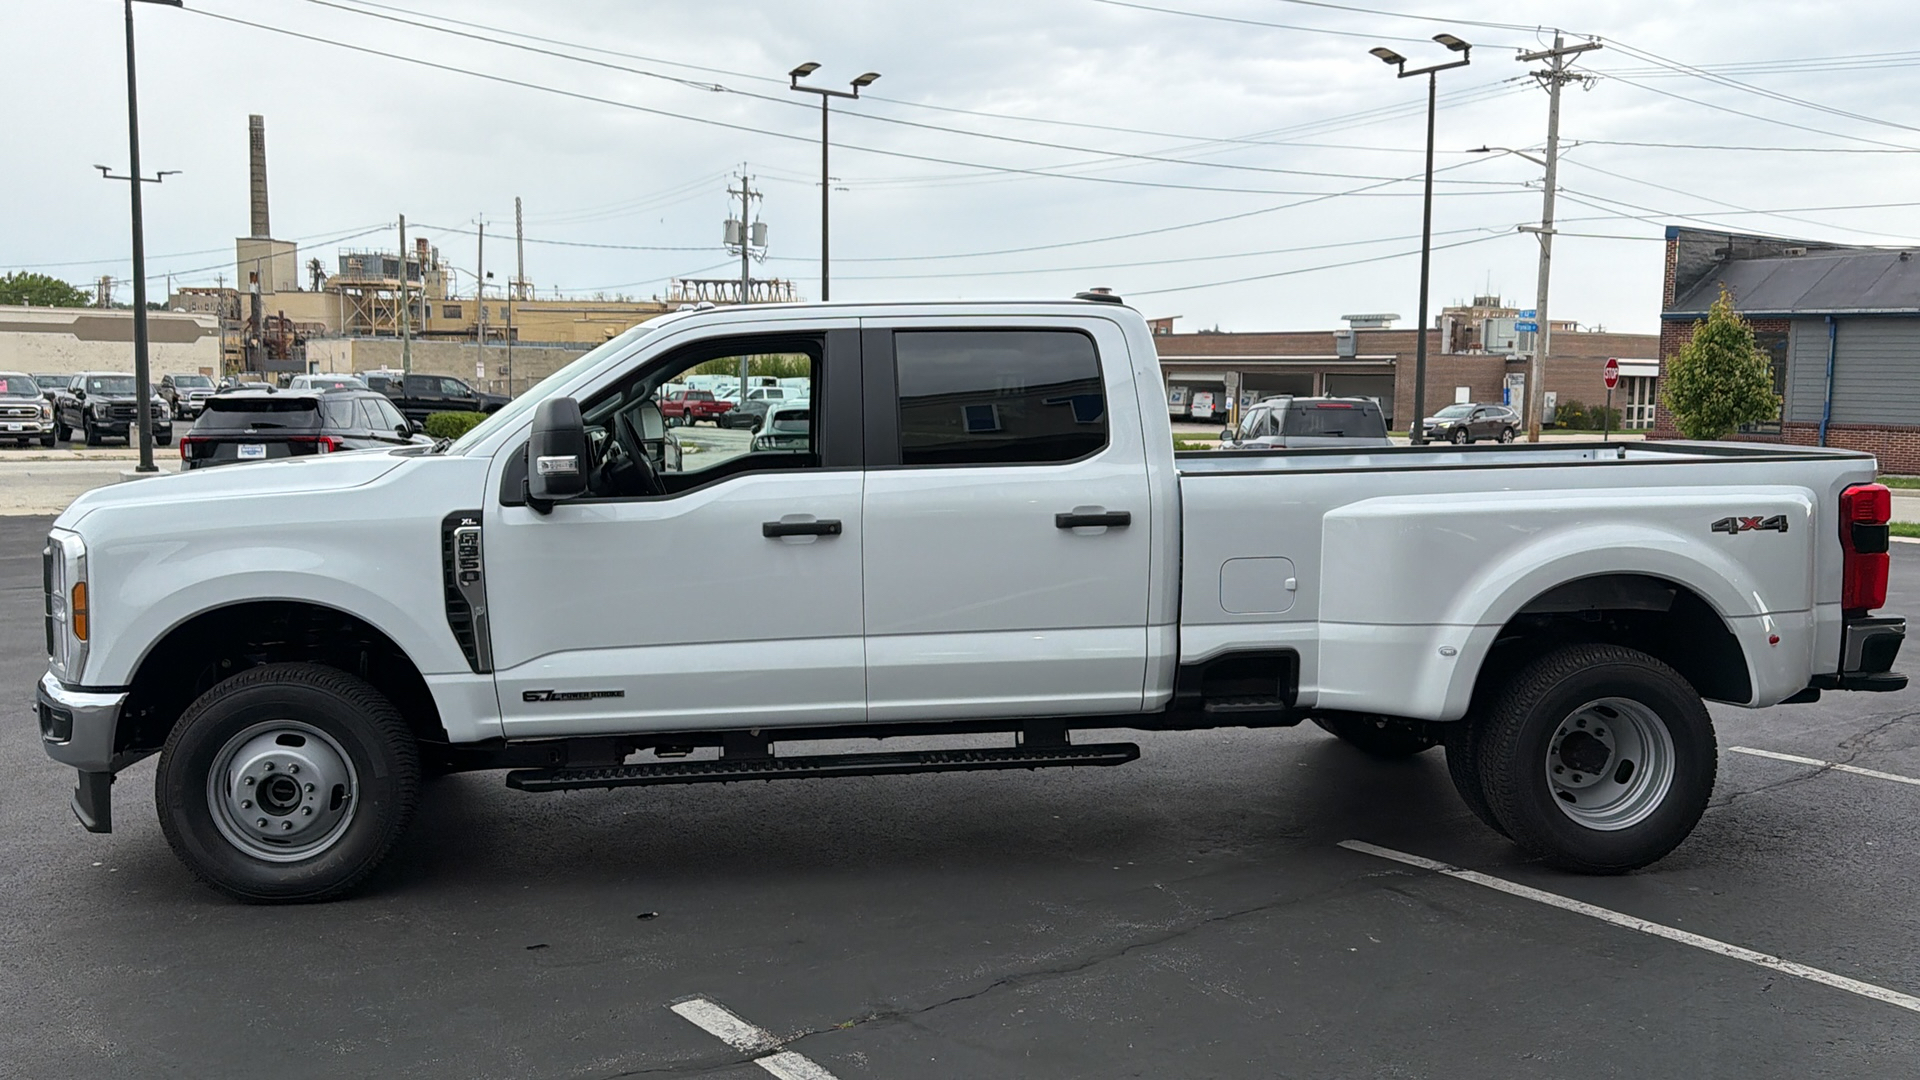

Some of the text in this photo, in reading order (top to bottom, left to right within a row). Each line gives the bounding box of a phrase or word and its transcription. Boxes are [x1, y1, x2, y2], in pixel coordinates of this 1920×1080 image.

[1604, 367, 1618, 380] STOP
[522, 689, 625, 702] 6.7L POWER STROKE
